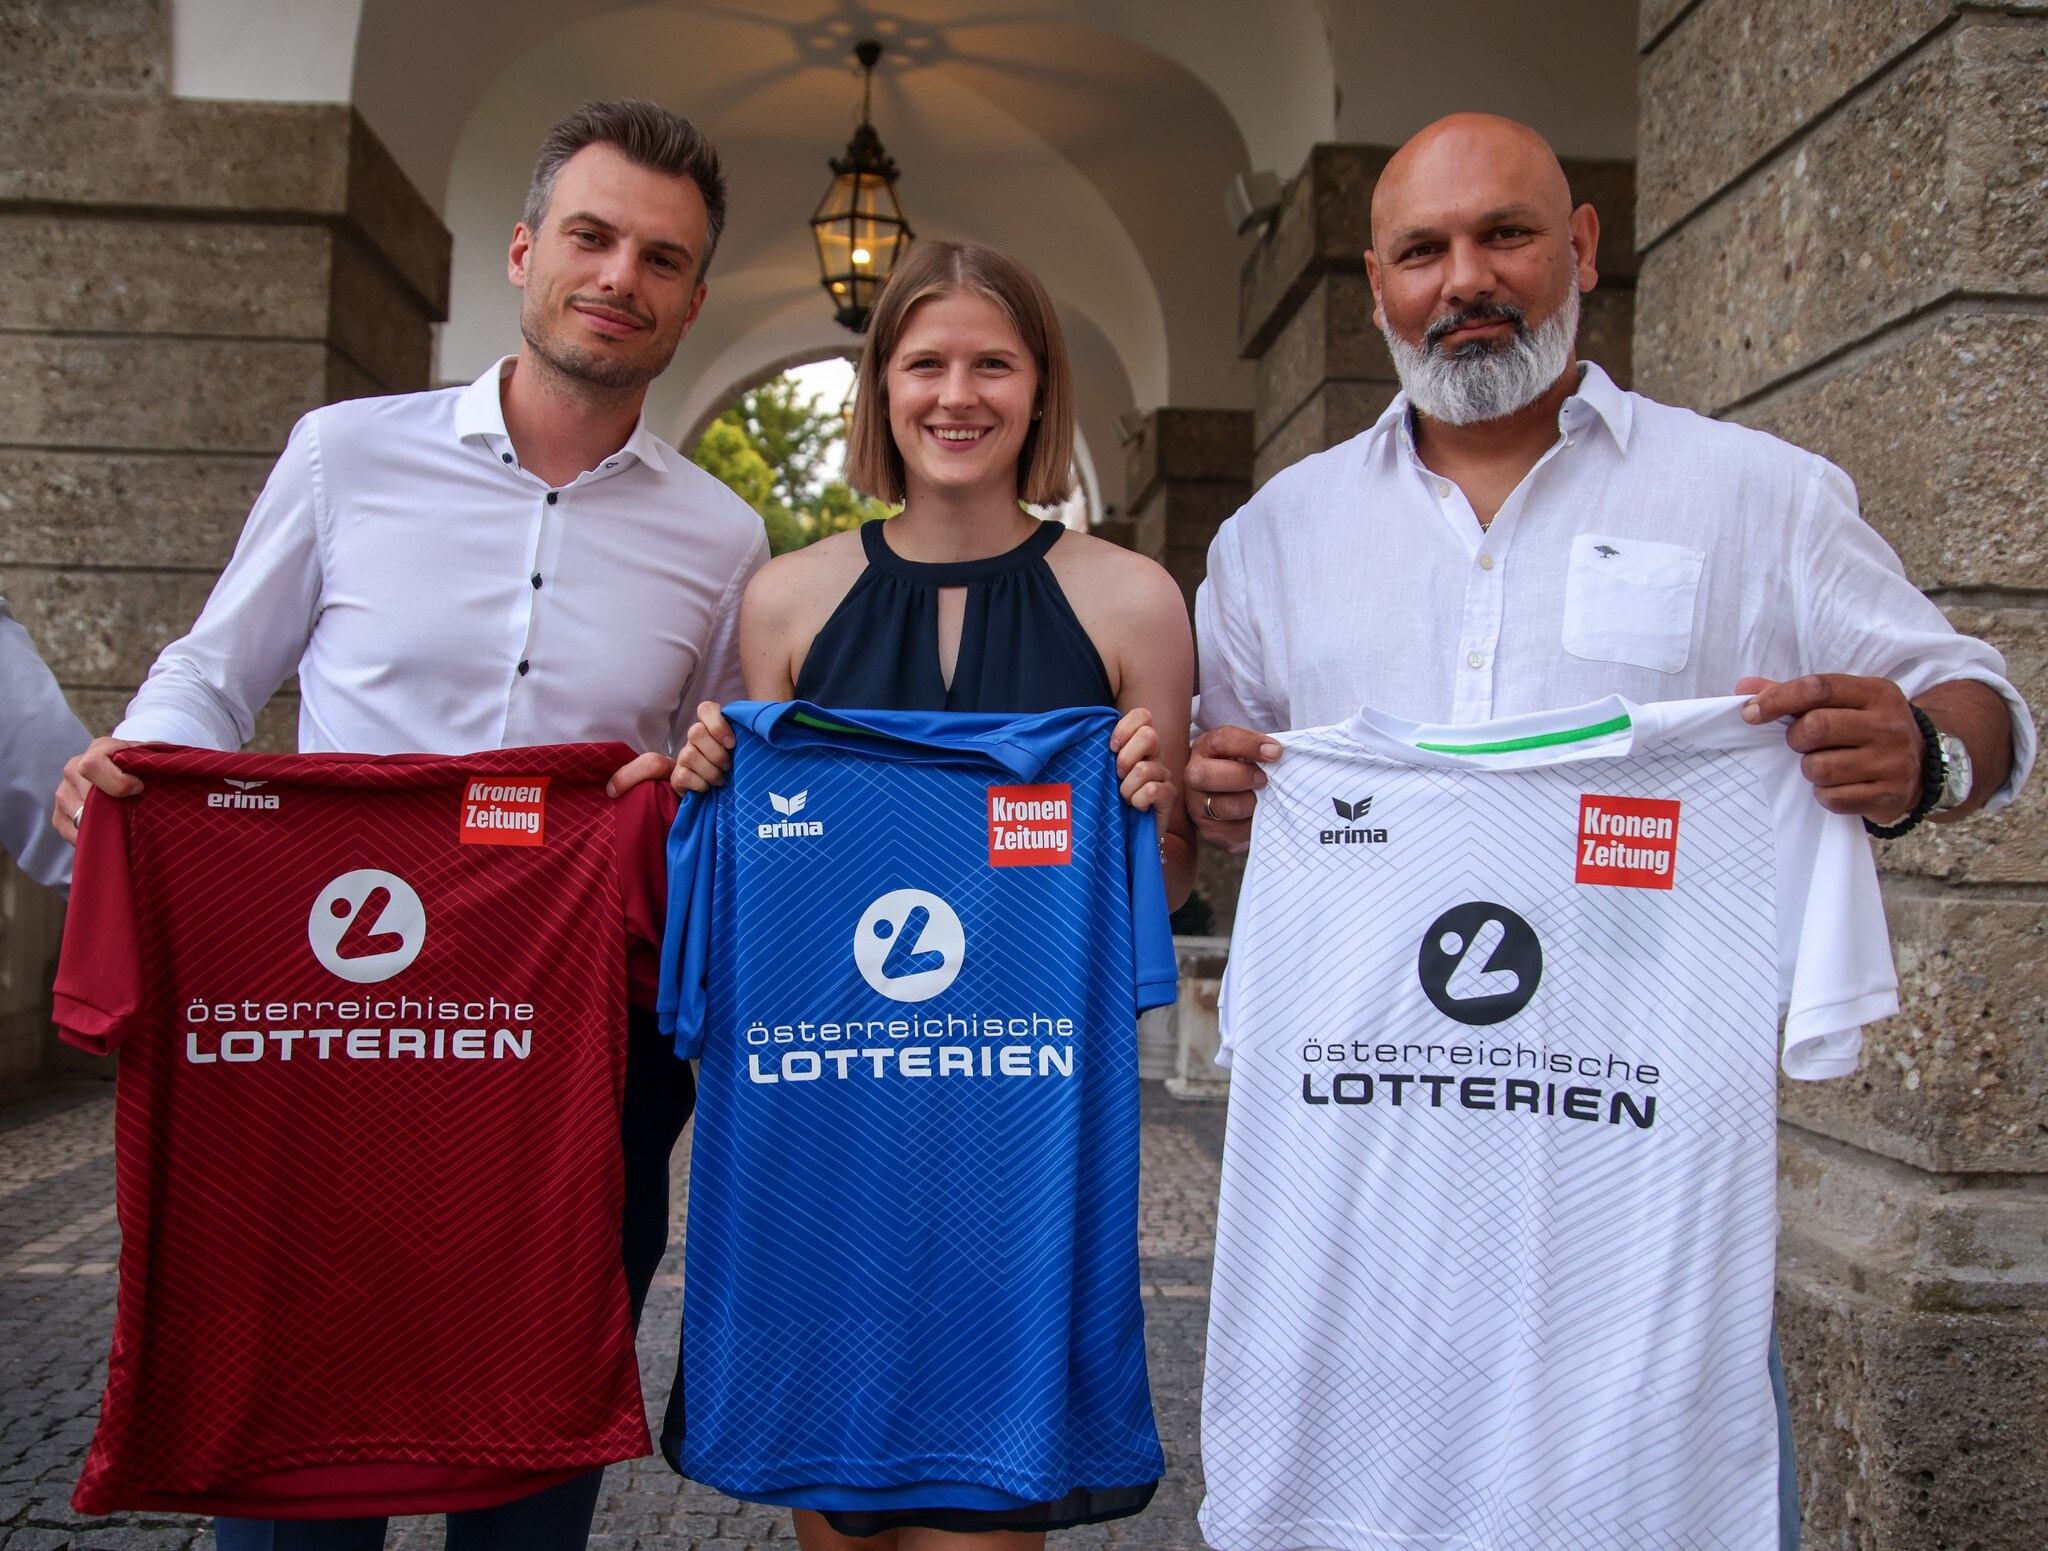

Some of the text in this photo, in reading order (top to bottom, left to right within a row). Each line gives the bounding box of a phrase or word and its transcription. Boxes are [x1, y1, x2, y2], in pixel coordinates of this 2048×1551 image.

[207, 791, 280, 810] erima
[468, 782, 542, 804] Kronen
[465, 805, 540, 833] Zeitung
[991, 796, 1068, 822] Kronen
[1584, 806, 1672, 840] Kronen
[758, 819, 824, 839] erima
[993, 825, 1068, 852] Zeitung
[1319, 824, 1388, 845] erima
[1581, 839, 1670, 874] Zeitung
[186, 996, 534, 1023] österreichische
[747, 1012, 1074, 1045] österreichische
[186, 1028, 533, 1064] LOTTERIEN
[748, 1045, 1074, 1084] LOTTERIEN
[1302, 1037, 1660, 1084] österreichische
[1302, 1073, 1657, 1129] LOTTERIEN
